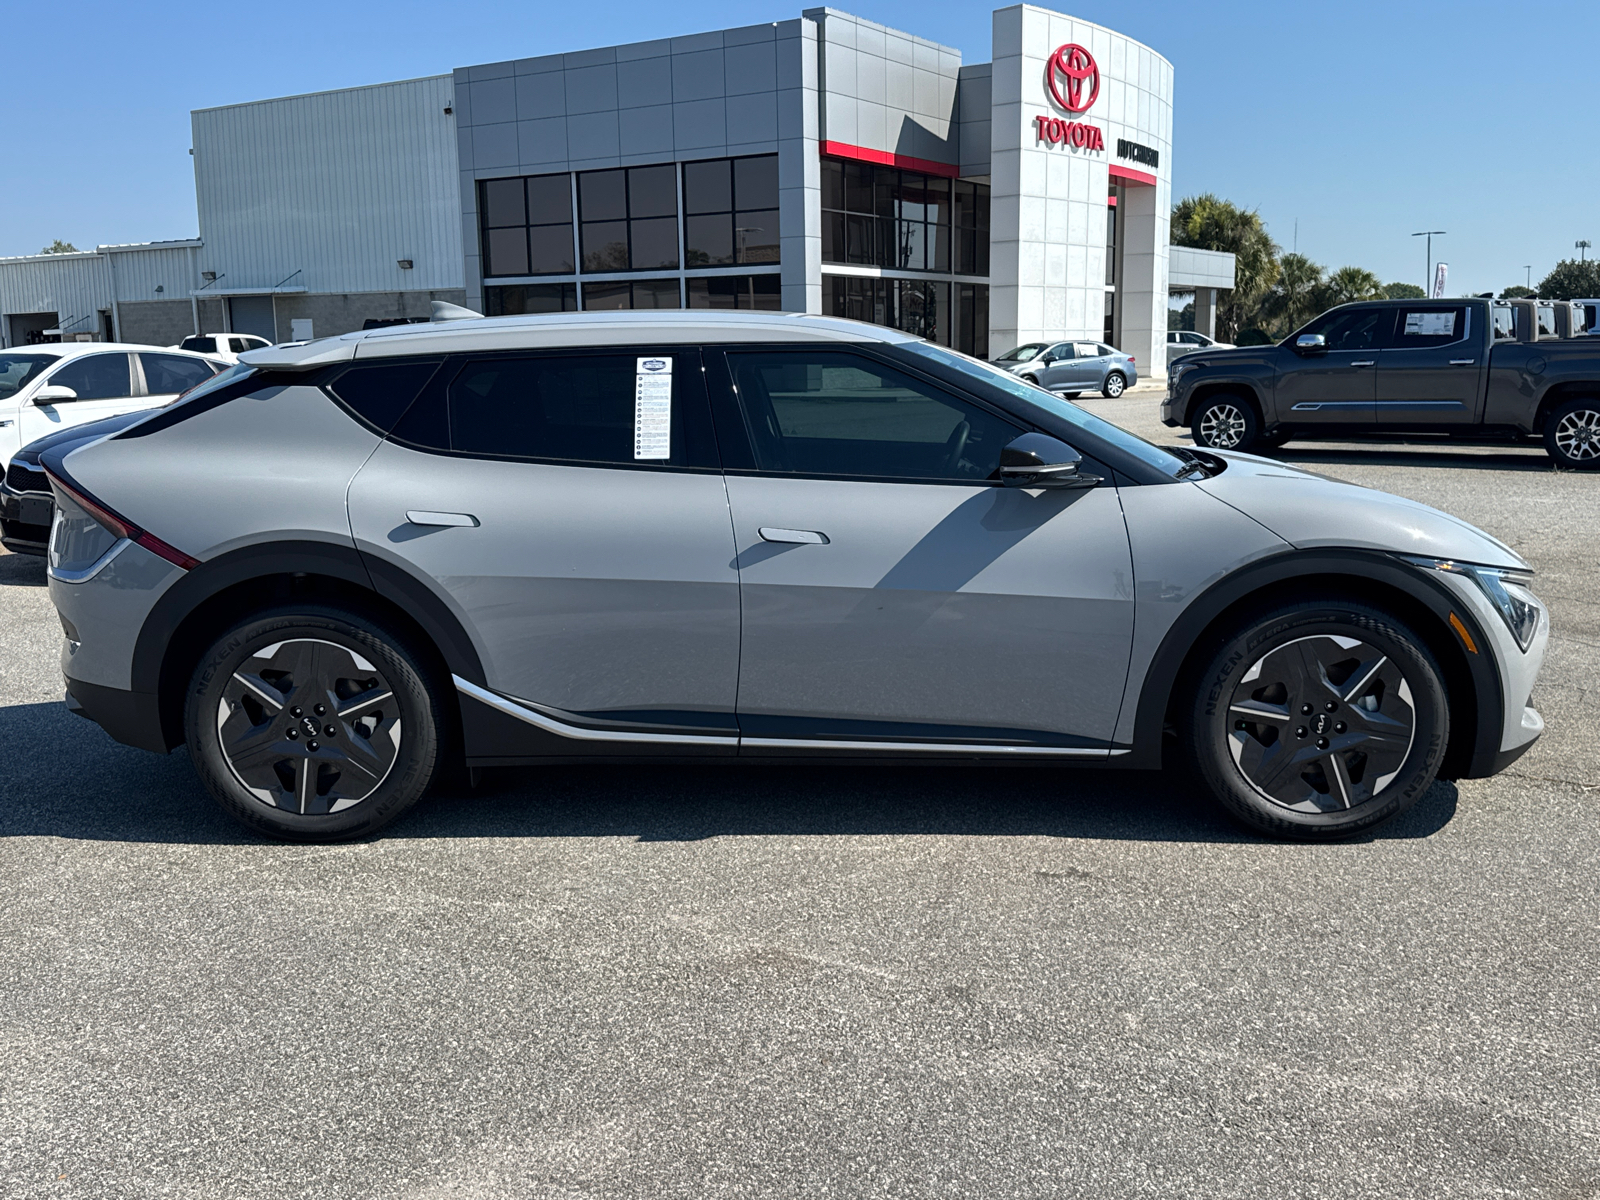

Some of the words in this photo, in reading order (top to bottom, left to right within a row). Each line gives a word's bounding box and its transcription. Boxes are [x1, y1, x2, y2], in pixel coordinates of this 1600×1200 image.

[1035, 115, 1105, 152] TOYOTA
[196, 636, 241, 697] NEXEN
[1205, 650, 1244, 716] NEXEN
[374, 758, 420, 817] NEXEN
[1402, 733, 1441, 799] NEXEN
